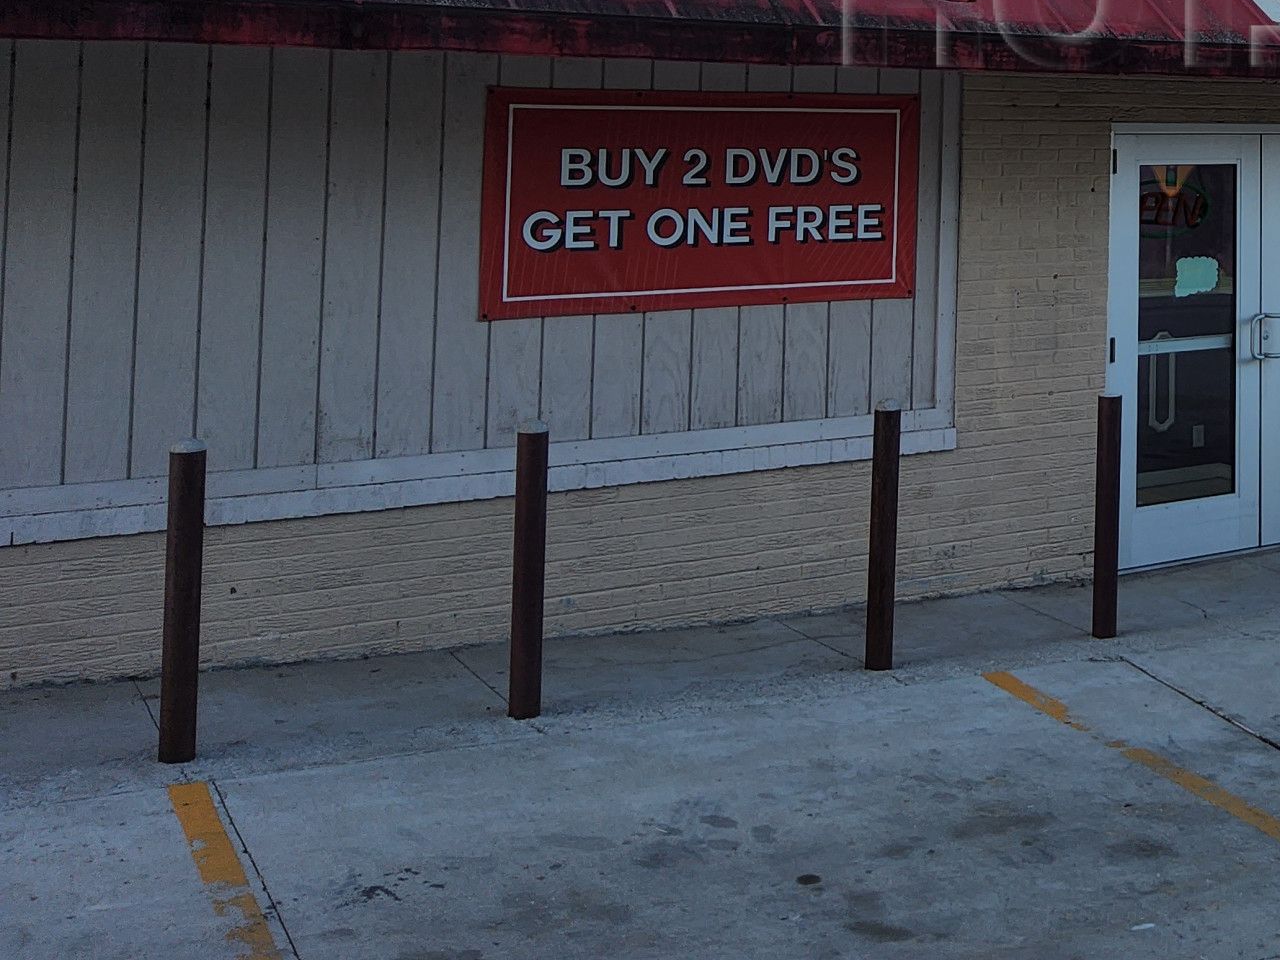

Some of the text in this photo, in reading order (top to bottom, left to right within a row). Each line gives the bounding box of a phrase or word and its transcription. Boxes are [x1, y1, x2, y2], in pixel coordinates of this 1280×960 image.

[560, 146, 860, 188] BUY 2 DVD'S
[521, 203, 884, 251] GET ONE FREE
